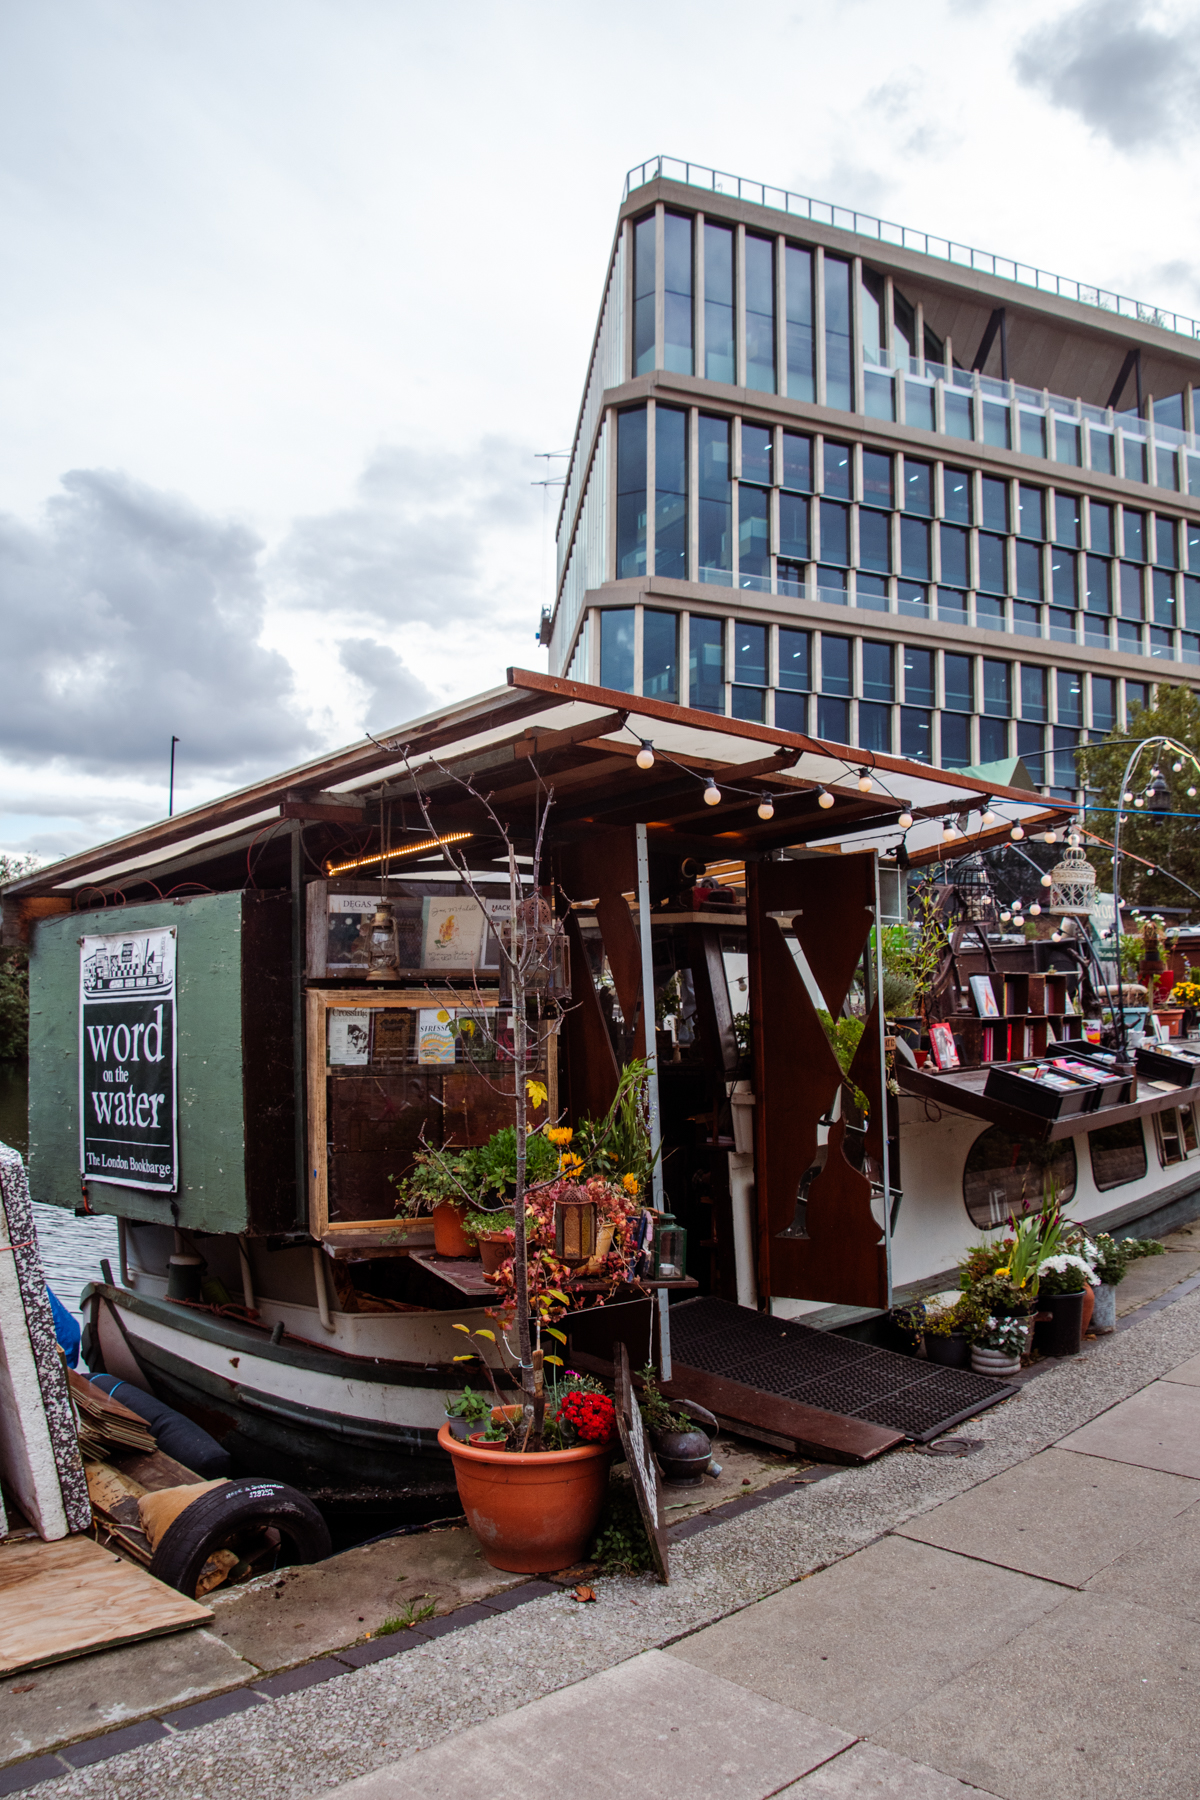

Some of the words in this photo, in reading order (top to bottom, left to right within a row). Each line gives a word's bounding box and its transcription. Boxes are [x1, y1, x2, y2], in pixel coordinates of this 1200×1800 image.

[343, 900, 372, 908] DEGAS
[332, 1008, 368, 1018] Crossing
[87, 1004, 165, 1062] word
[102, 1069, 113, 1083] on
[114, 1065, 129, 1083] the
[91, 1084, 166, 1128] water
[86, 1152, 101, 1166] The
[101, 1153, 129, 1170] London
[129, 1156, 171, 1178] Bookbarge
